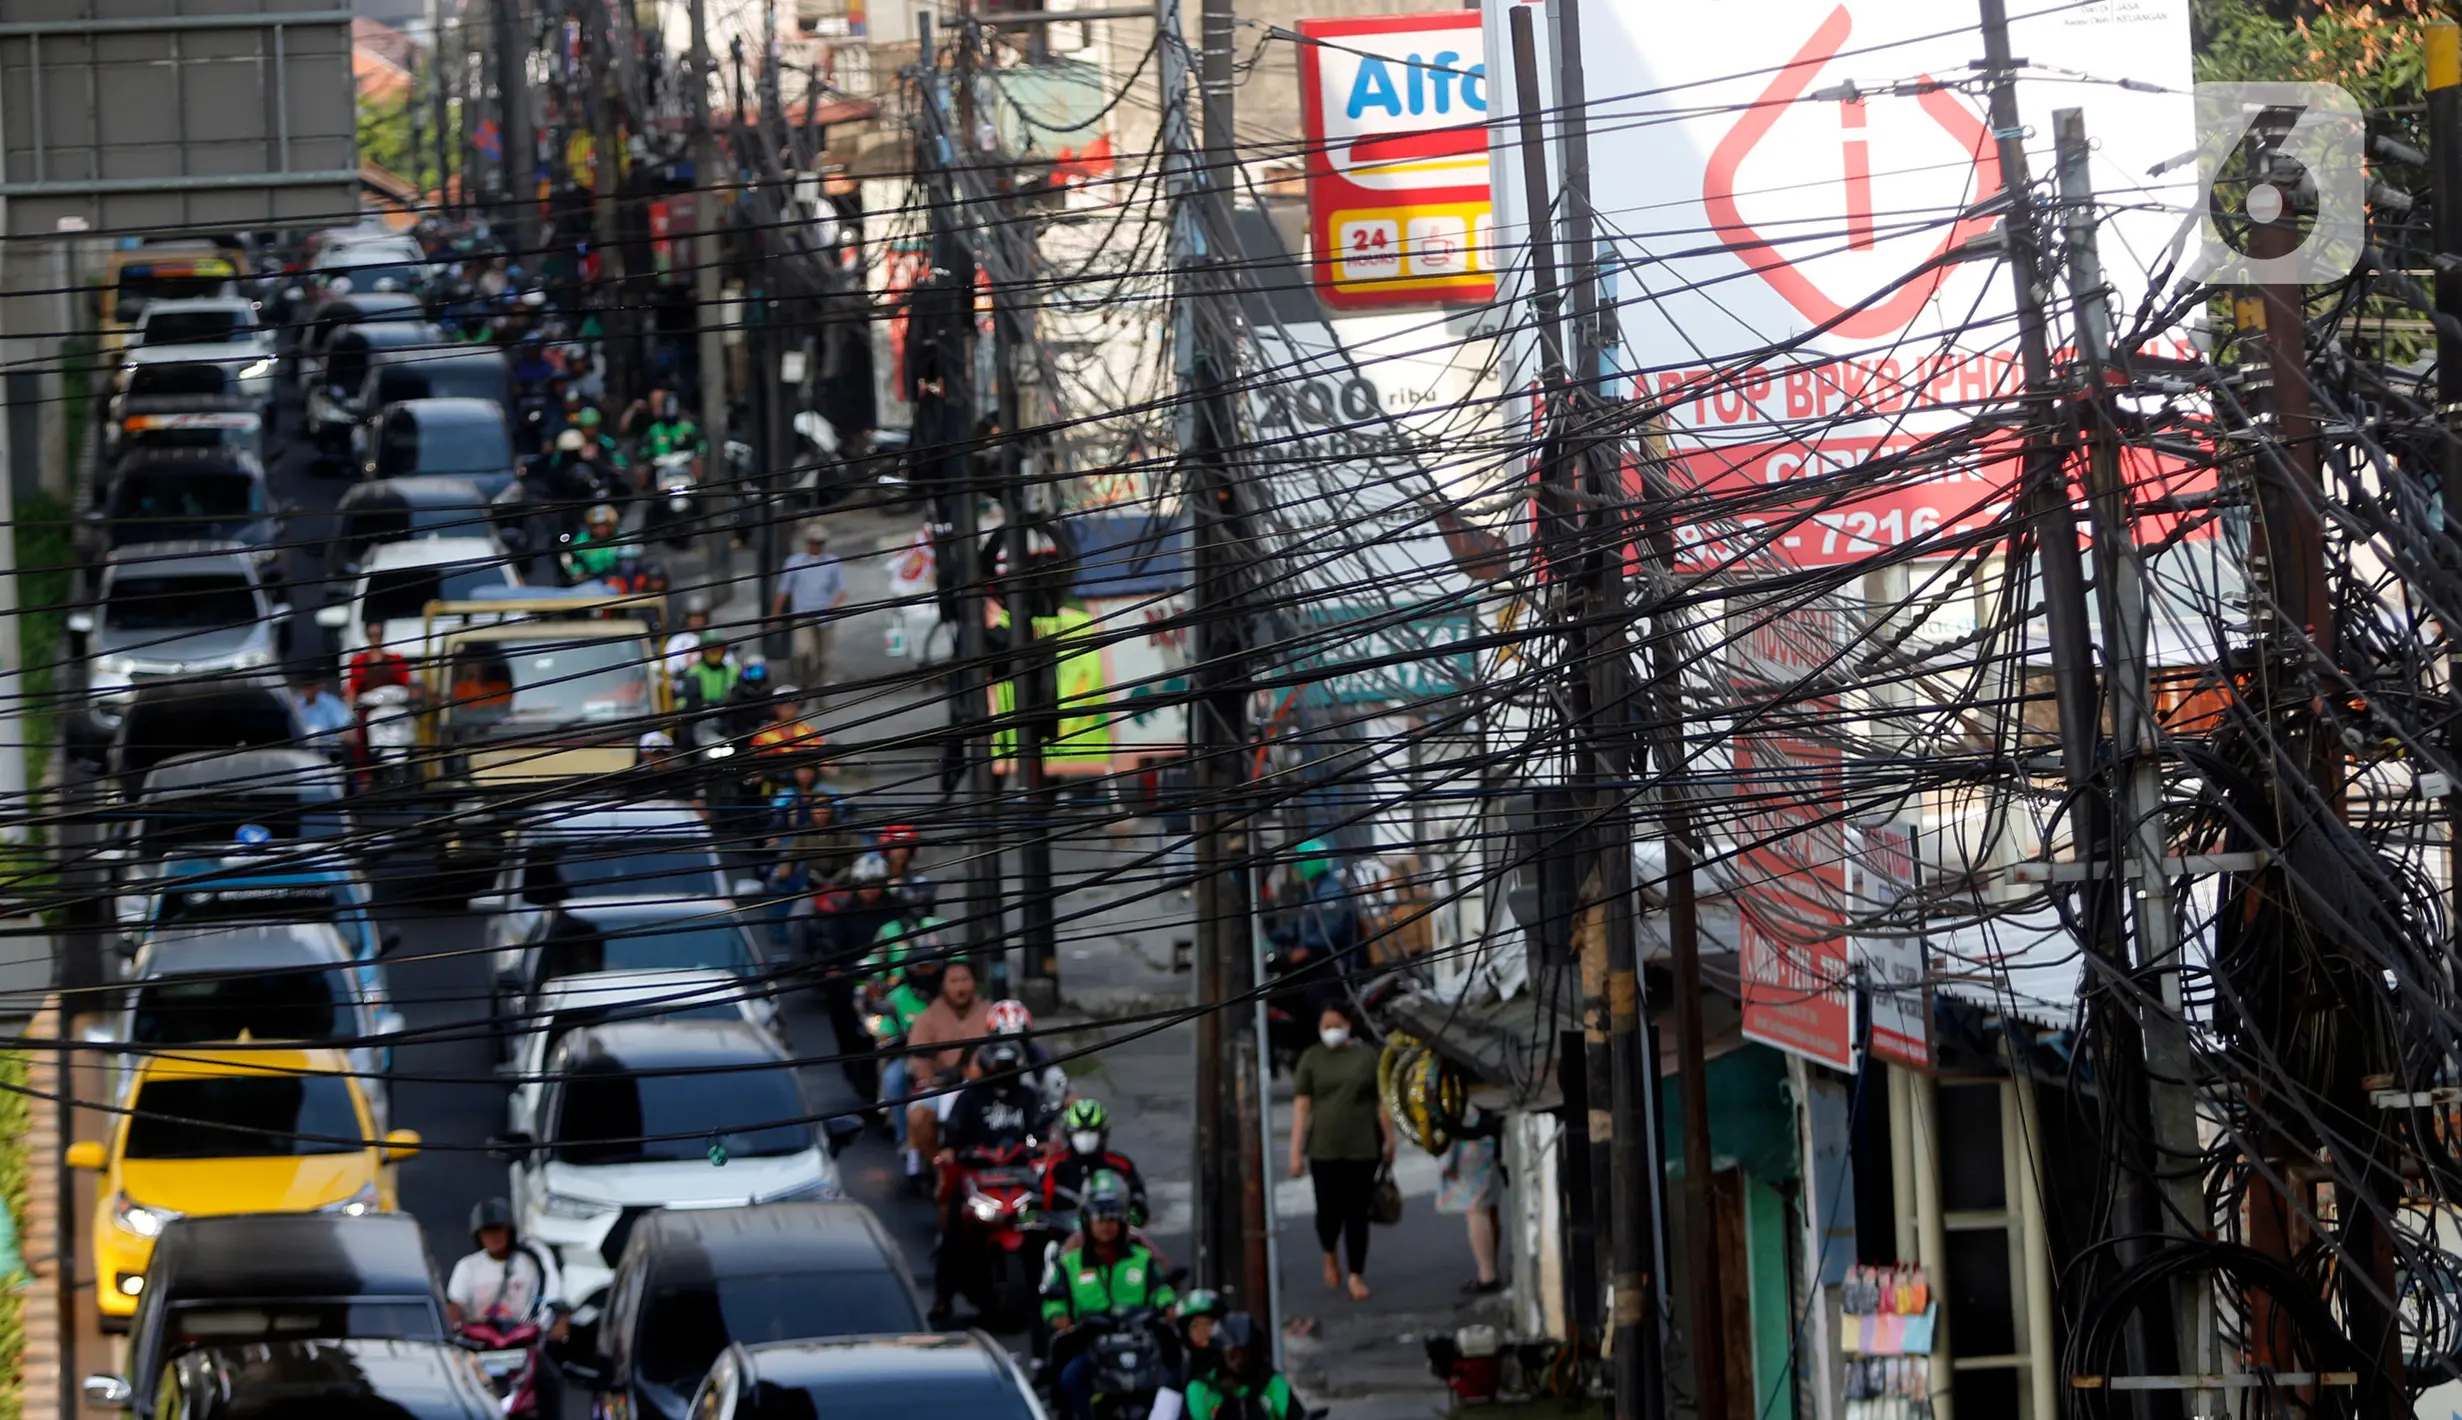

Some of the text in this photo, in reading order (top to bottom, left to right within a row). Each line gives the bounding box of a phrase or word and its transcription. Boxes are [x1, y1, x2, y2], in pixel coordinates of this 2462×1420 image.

[1352, 227, 1388, 251] 24
[1389, 387, 1437, 406] ribu
[1784, 350, 1901, 419] BPKB
[1820, 506, 1943, 556] 7216
